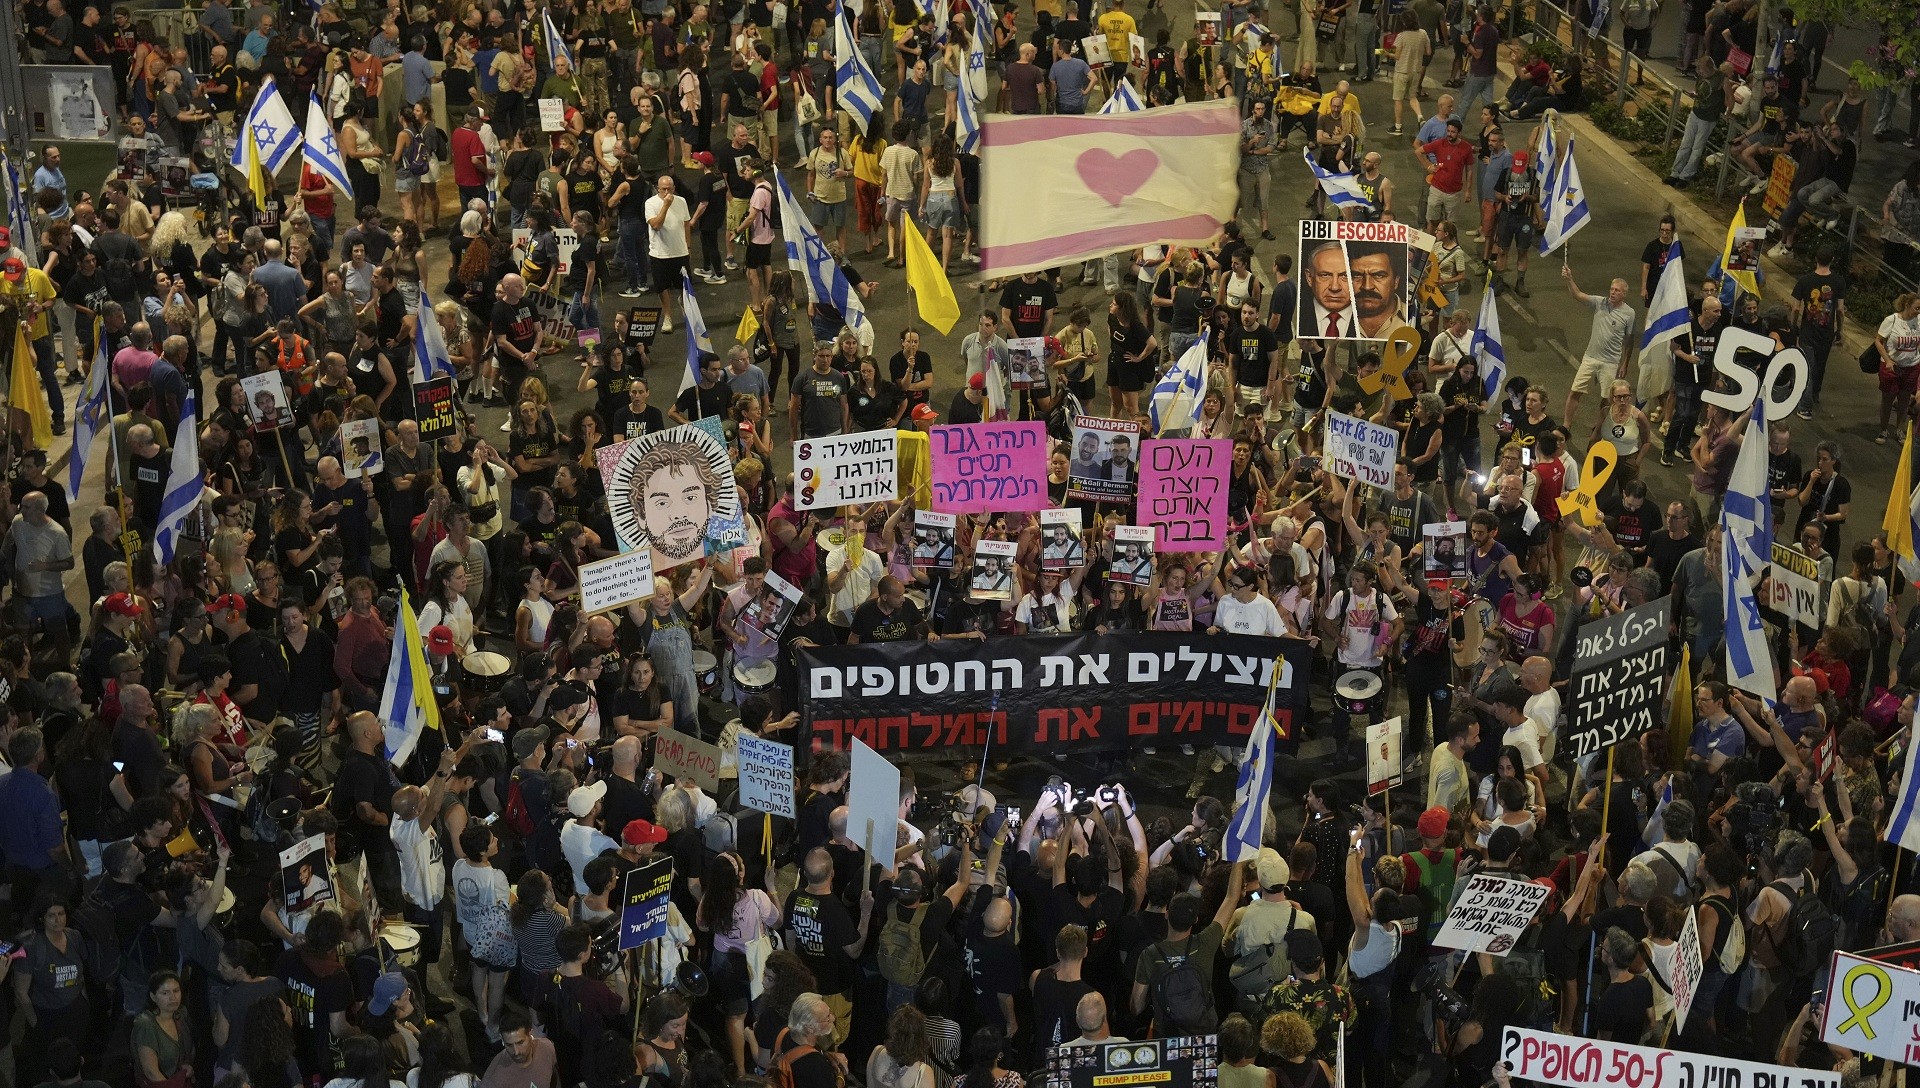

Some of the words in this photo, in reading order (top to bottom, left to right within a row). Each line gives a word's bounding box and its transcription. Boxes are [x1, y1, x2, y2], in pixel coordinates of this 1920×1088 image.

[1302, 220, 1332, 238] BIBI
[1336, 222, 1407, 242] ESCOBAR
[1700, 326, 1809, 421] 50
[418, 385, 450, 404] הפקרה
[420, 418, 440, 433] מלא
[440, 414, 452, 428] על
[1077, 418, 1138, 432] KIDNAPPED
[932, 428, 980, 454] גבר
[985, 428, 1036, 450] תהיה
[1354, 422, 1368, 442] על
[1371, 428, 1394, 448] תודה
[823, 437, 894, 459] הממשלה
[1153, 444, 1213, 471] העם
[1370, 448, 1385, 466] מה
[1359, 464, 1389, 485] עמרי
[1104, 481, 1129, 489] Berman
[1159, 476, 1219, 494] רוצה
[1575, 492, 1592, 508] NOW.
[721, 529, 740, 541] אלון
[615, 556, 636, 570] there's
[582, 575, 611, 588] countries
[619, 569, 633, 578] isn't
[636, 564, 650, 574] hard
[594, 586, 602, 595] do
[603, 580, 628, 593] Nothing
[637, 574, 647, 584] kill
[608, 594, 617, 602] die
[1796, 588, 1815, 616] אין
[1619, 610, 1663, 647] ובכל
[1040, 653, 1111, 687] את
[1128, 646, 1293, 689] מצילים
[1620, 646, 1665, 684] תציל
[811, 658, 1023, 698] החטופים
[1577, 667, 1612, 698] את
[1577, 675, 1663, 726] המדינה
[812, 710, 1007, 754] המלחמה
[1034, 706, 1102, 743] את
[782, 749, 791, 757] לא
[748, 774, 791, 792] ההפקרה
[749, 796, 791, 814] במנהרה
[653, 873, 670, 887] עתיד
[631, 883, 670, 903] הקואליציה
[1467, 892, 1484, 904] כל
[1506, 883, 1546, 900] העסקה
[646, 904, 667, 919] העתיד
[1515, 899, 1537, 913] היא
[631, 918, 654, 934] ישראל
[654, 913, 666, 925] של
[1488, 911, 1529, 928] החטופים
[1096, 1076, 1129, 1085] TRUMP
[1132, 1073, 1168, 1082] PLEASE
